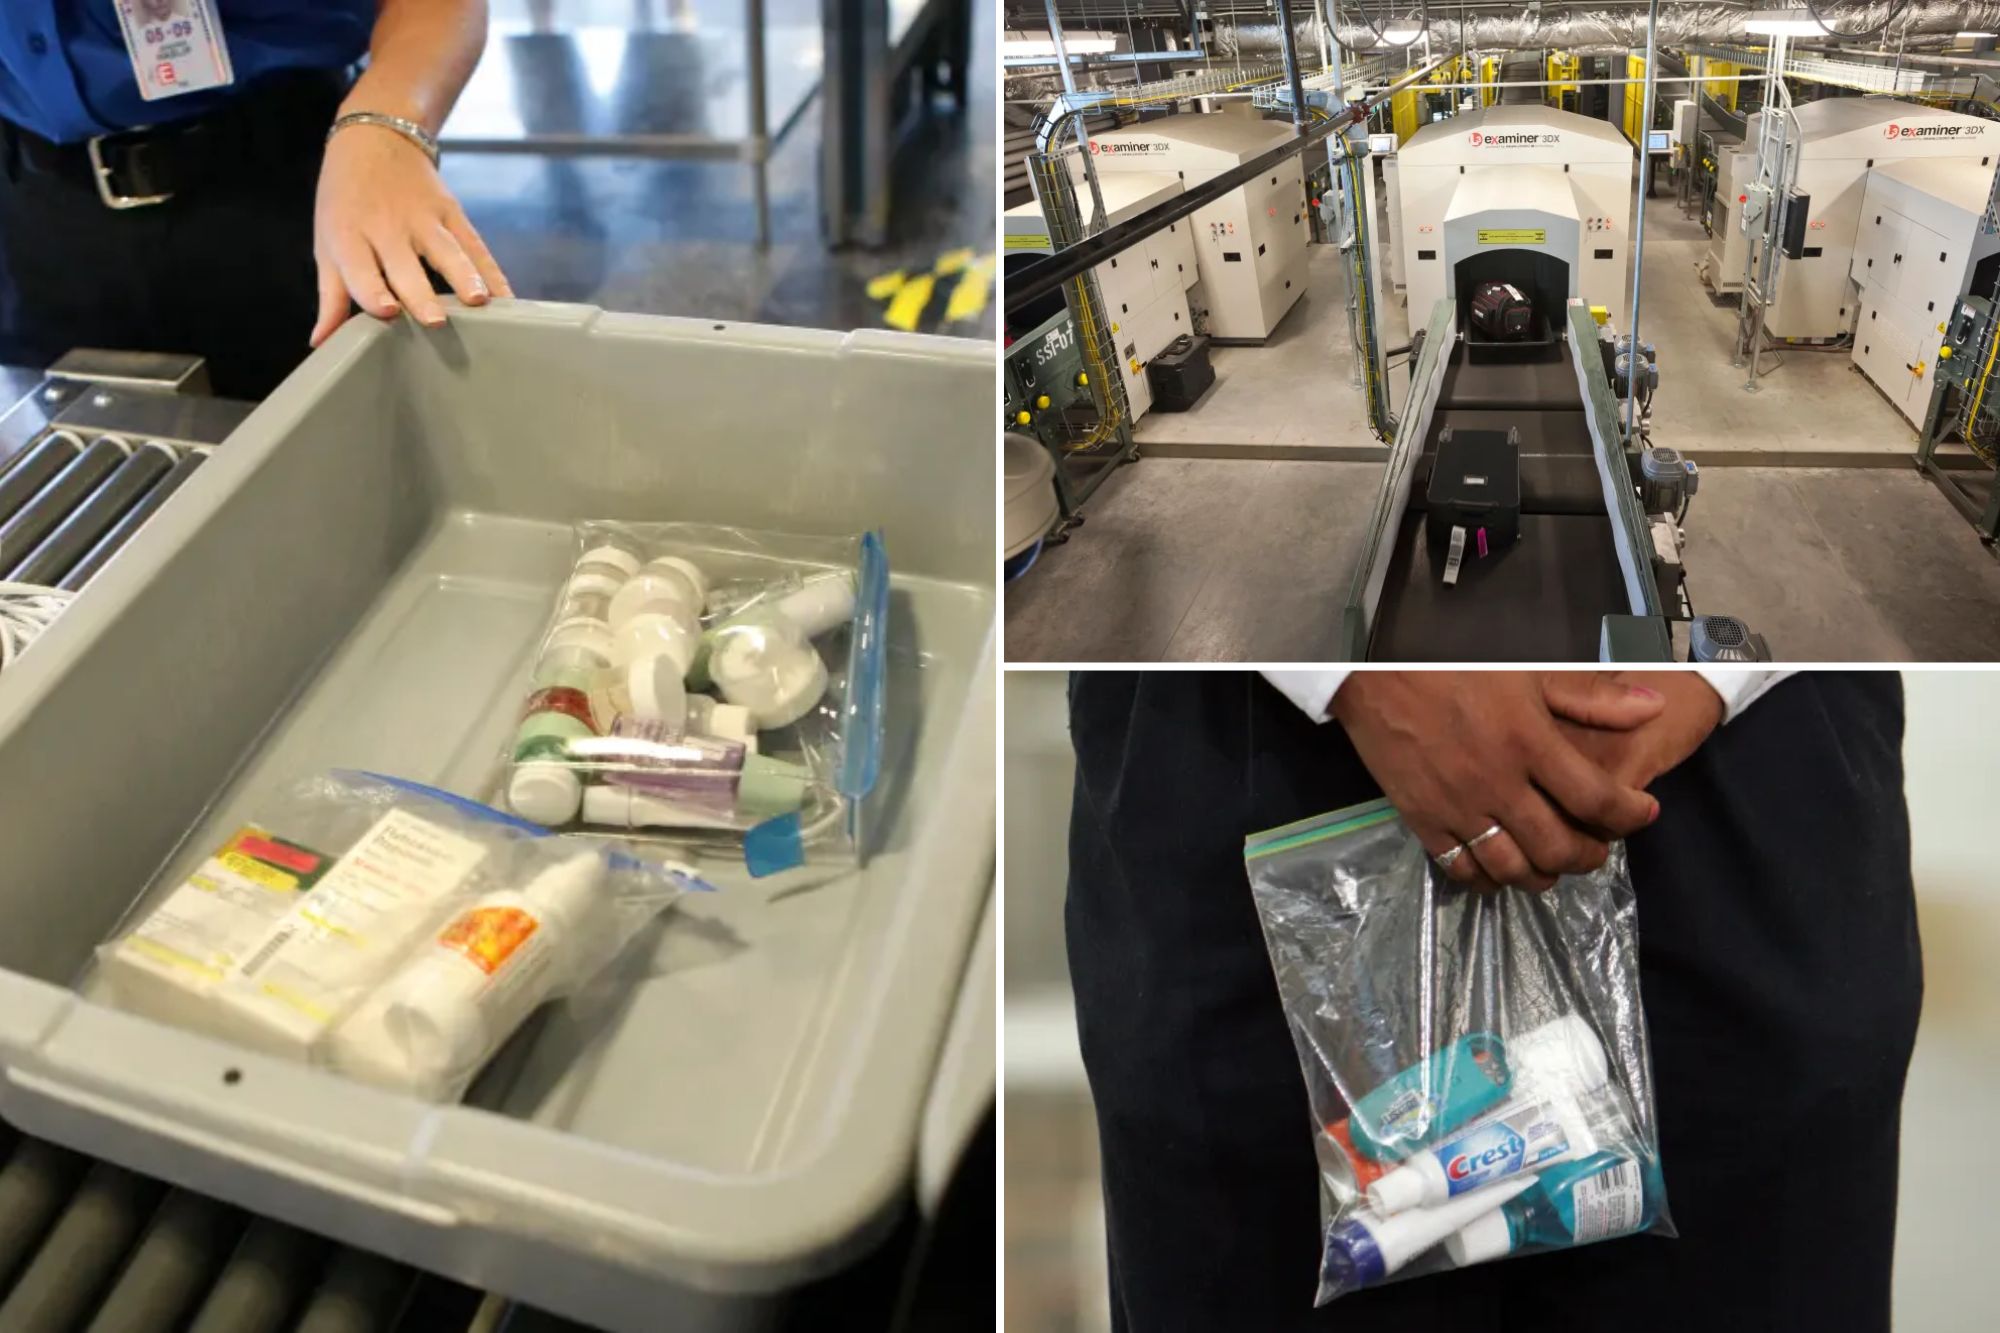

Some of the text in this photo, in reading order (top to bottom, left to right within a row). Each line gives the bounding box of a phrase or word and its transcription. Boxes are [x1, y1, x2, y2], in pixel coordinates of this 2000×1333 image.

[1900, 125, 1962, 136] examiner
[1964, 125, 1985, 135] 3DX
[1484, 132, 1539, 144] examiner
[1542, 134, 1560, 143] 3DX
[1101, 141, 1170, 152] examiner 3DX
[1447, 1134, 1521, 1180] Crest
